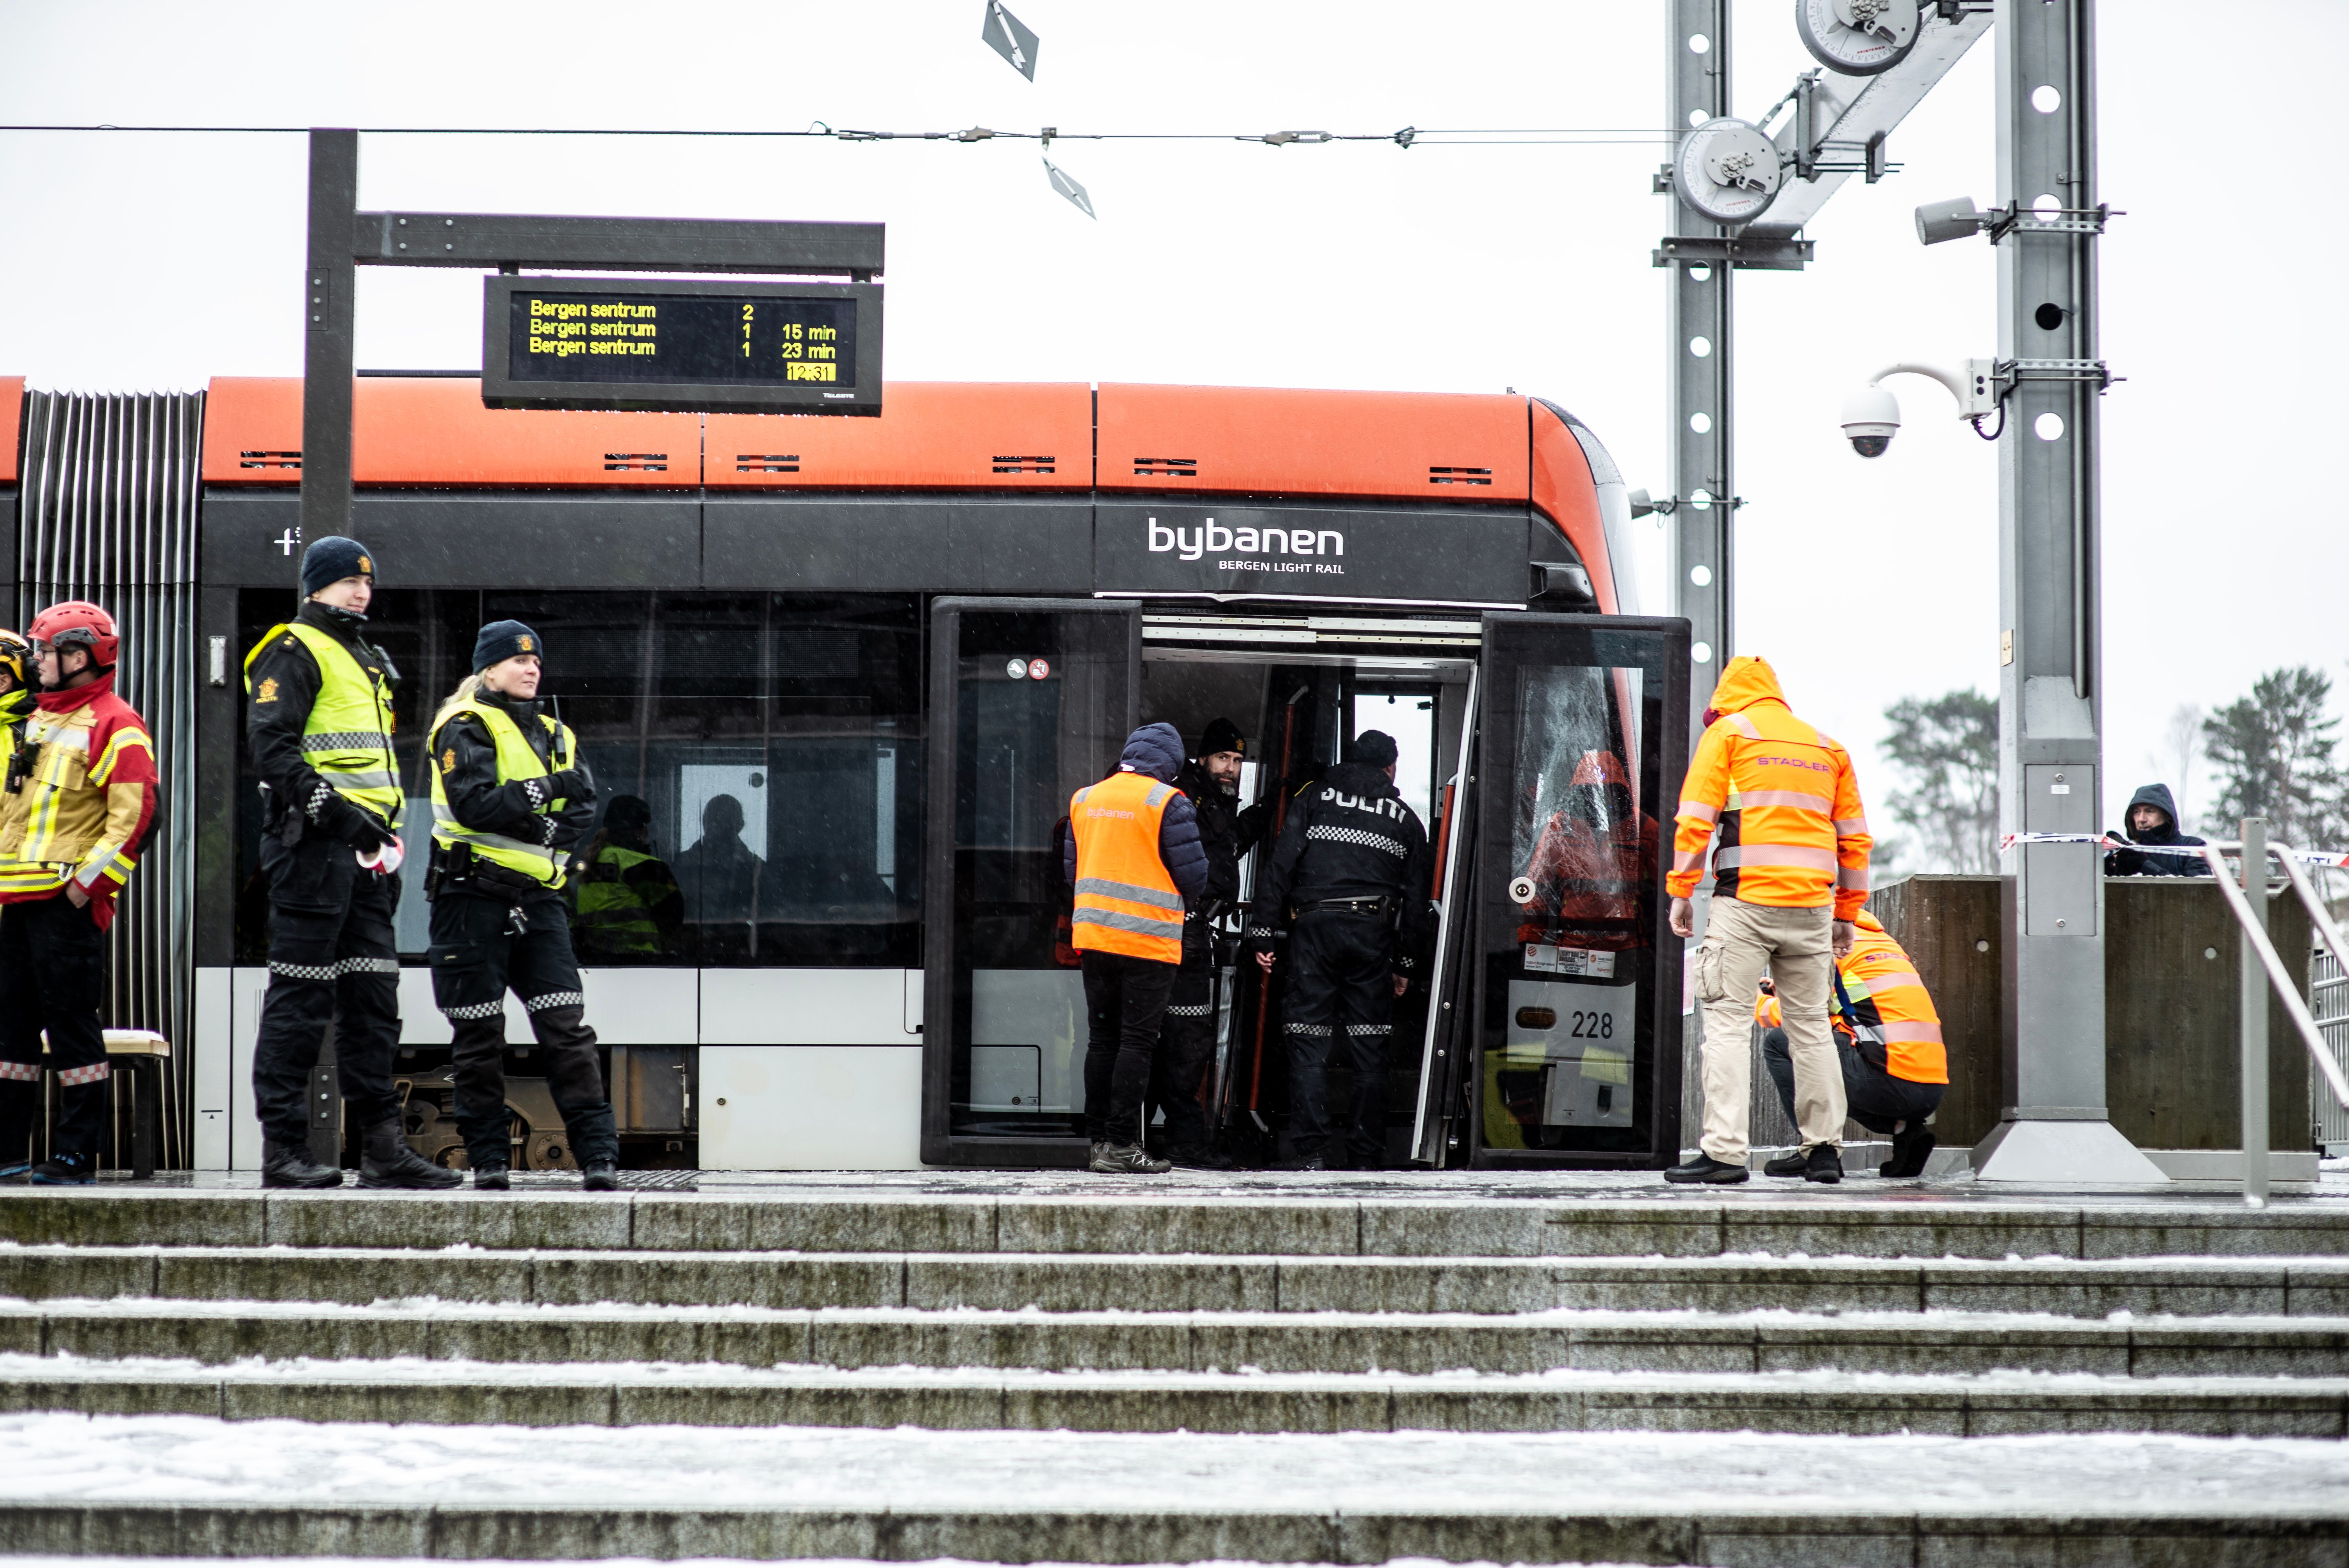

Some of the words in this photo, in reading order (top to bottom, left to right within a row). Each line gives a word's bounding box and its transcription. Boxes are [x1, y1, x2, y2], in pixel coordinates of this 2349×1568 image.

[531, 300, 586, 319] Bergen
[590, 302, 656, 317] sentrum
[743, 304, 754, 320] 2
[530, 319, 586, 338] Bergen
[590, 320, 656, 336] sentrum
[743, 323, 750, 339] 1
[782, 324, 802, 340] 15
[809, 325, 836, 340] min
[530, 337, 586, 356] Bergen
[590, 339, 655, 355] sentrum
[742, 342, 750, 357] 1
[782, 342, 802, 358] 23
[808, 343, 836, 359] min
[787, 365, 829, 380] 12:31
[1148, 517, 1344, 561] bybanen
[1219, 560, 1270, 571] BERGEN
[1274, 563, 1312, 572] LIGHT
[1315, 564, 1345, 574] RAIL
[1758, 757, 1830, 773] STADLER
[1087, 806, 1134, 820] bybanen
[1572, 1010, 1613, 1039] 228
